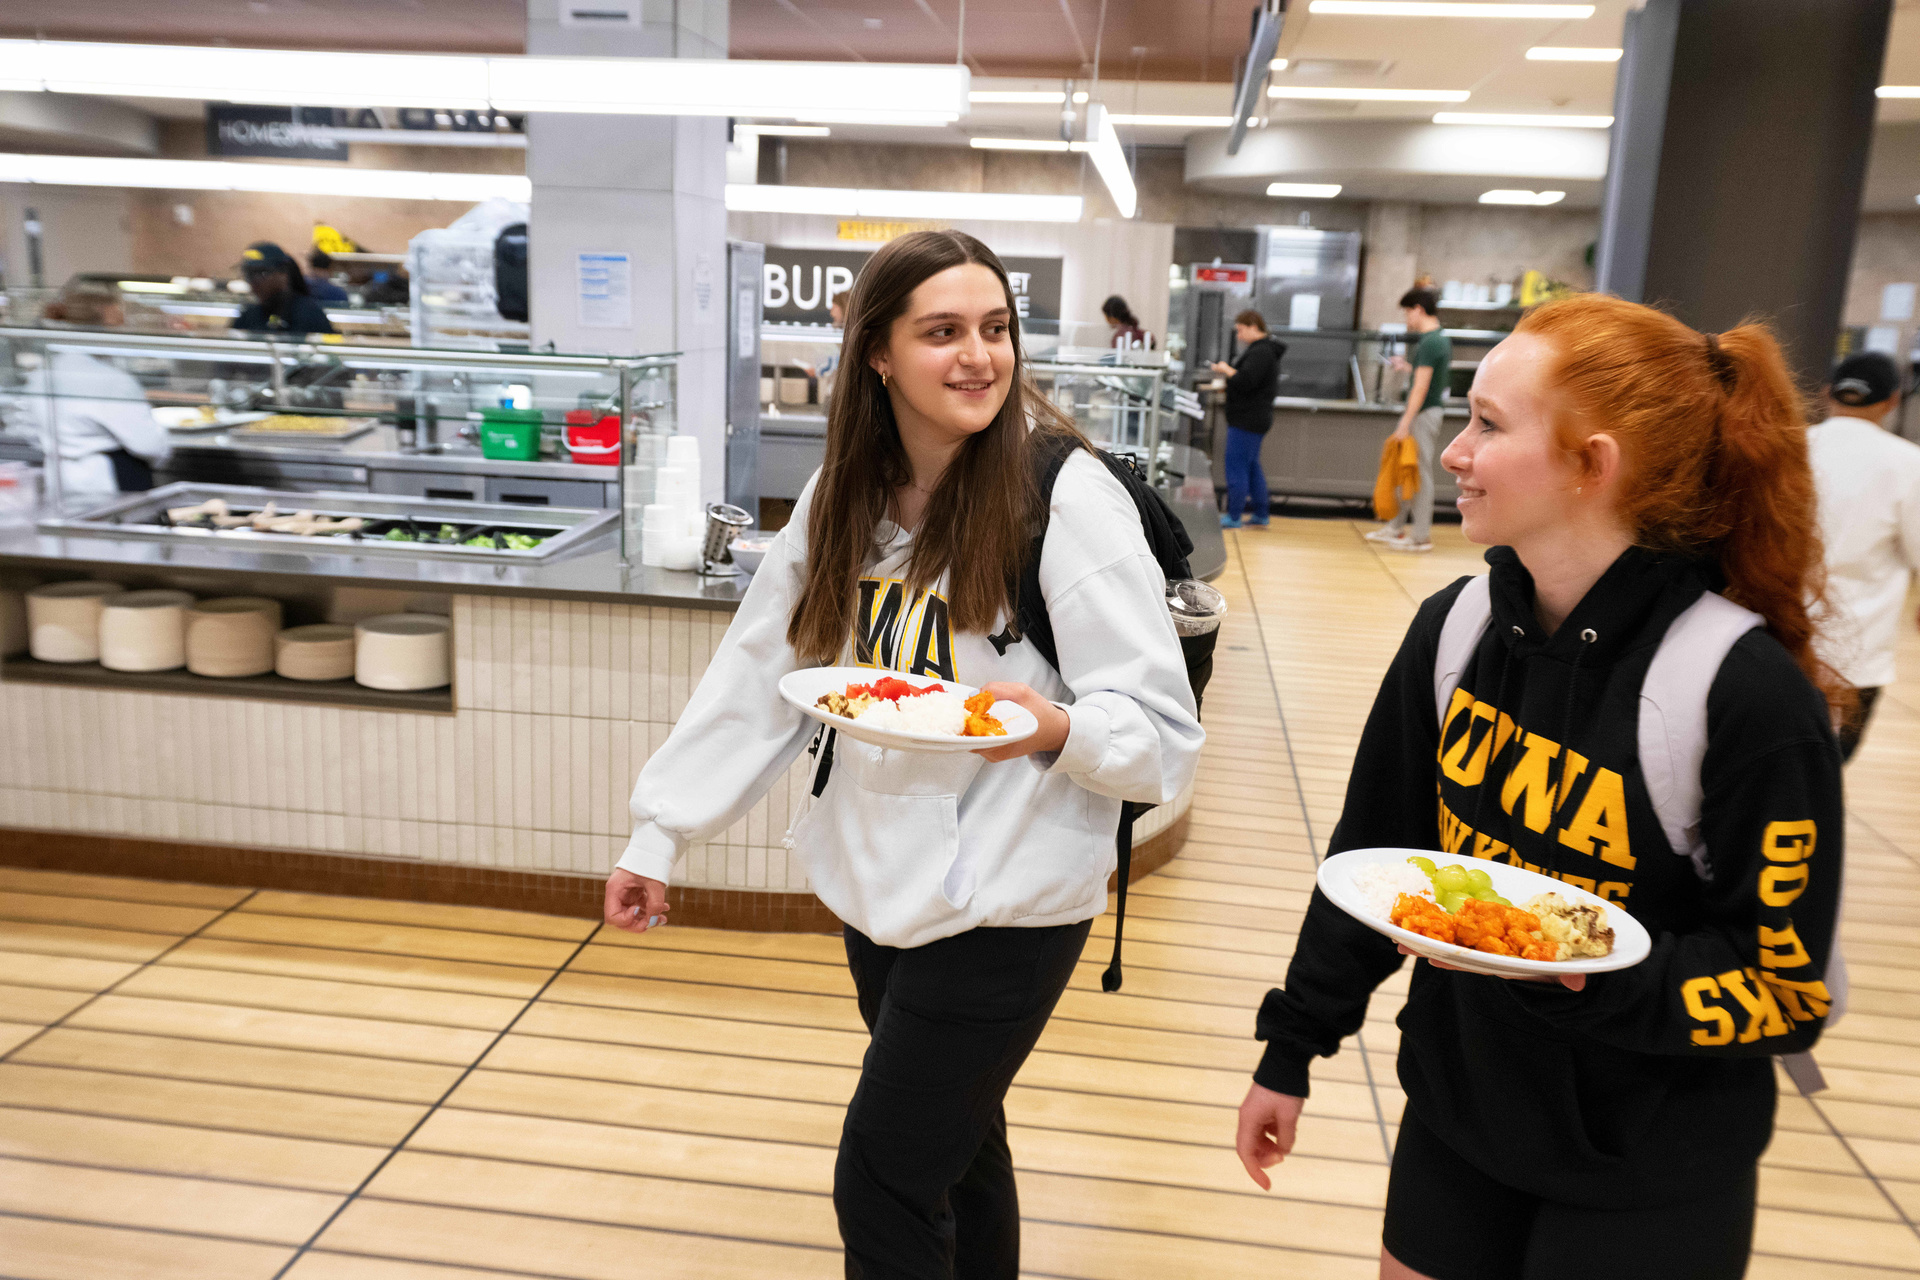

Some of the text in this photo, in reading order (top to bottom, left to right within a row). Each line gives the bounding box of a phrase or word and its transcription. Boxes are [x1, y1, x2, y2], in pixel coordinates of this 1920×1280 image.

[850, 576, 960, 684] WA
[1437, 687, 1637, 871] IOWA
[1758, 819, 1818, 907] GO
